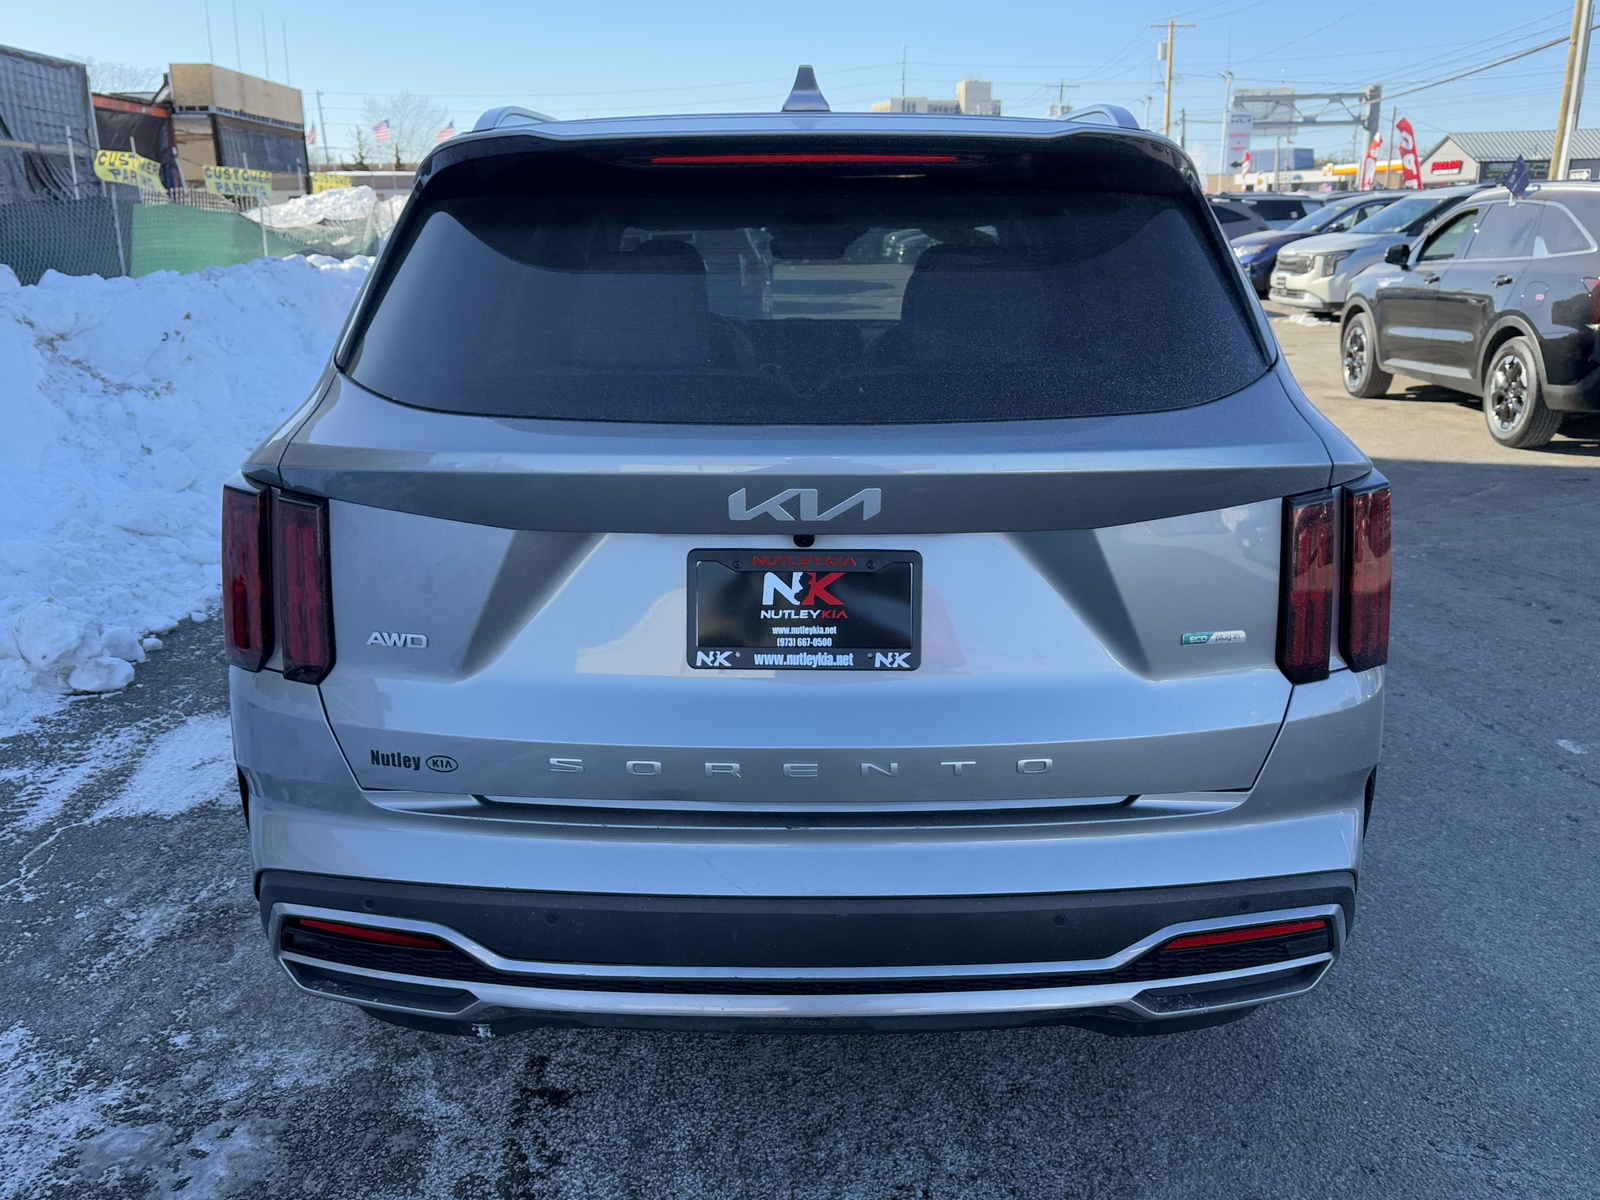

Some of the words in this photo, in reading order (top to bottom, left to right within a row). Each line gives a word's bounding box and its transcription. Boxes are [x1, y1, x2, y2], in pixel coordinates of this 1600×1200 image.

[98, 151, 160, 175] CUSTMER
[204, 167, 273, 184] CUSTOMER
[728, 487, 882, 521] KIA
[772, 625, 838, 635] www.nutleykia.net
[365, 631, 429, 649] AWD
[777, 637, 796, 647] (973)
[797, 637, 832, 647] 667-0500
[754, 652, 855, 668] www.nutleykia.net
[370, 749, 421, 771] Nutley
[431, 758, 453, 769] KIA
[548, 757, 1054, 779] SORENTO
